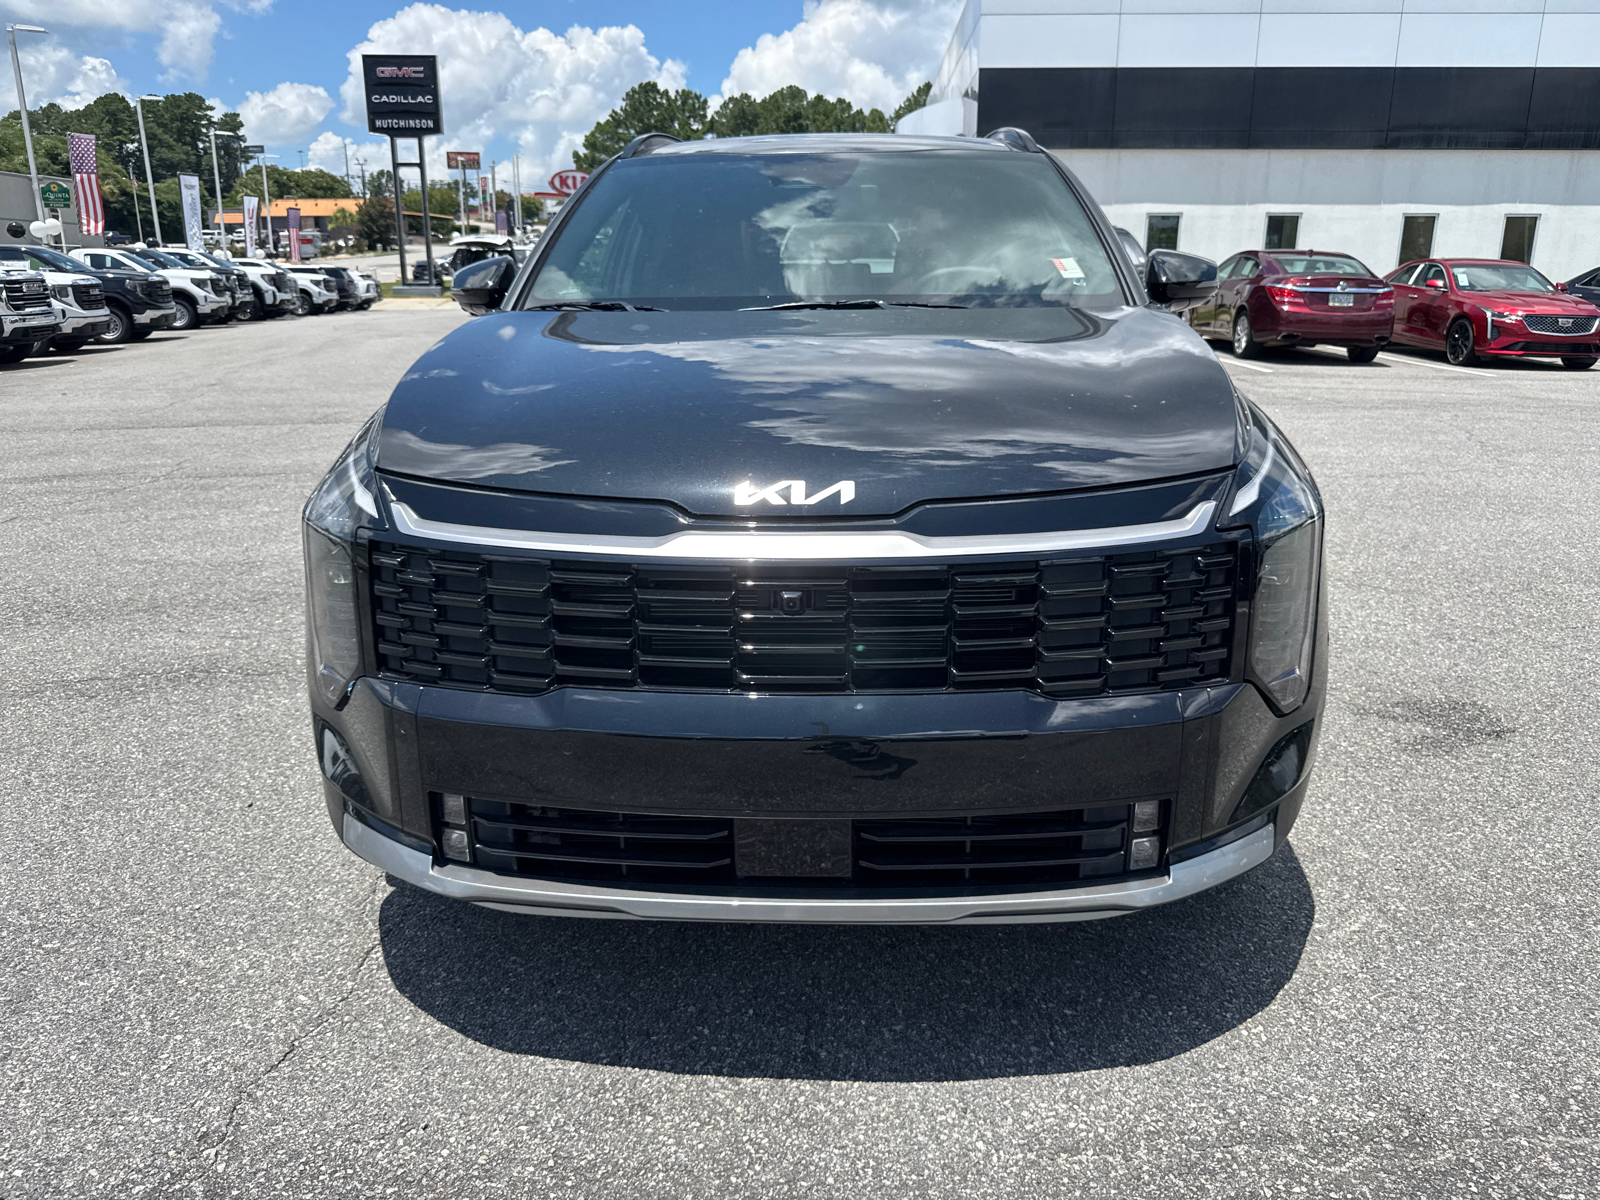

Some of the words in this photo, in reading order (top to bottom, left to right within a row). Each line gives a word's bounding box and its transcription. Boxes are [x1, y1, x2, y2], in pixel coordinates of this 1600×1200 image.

[376, 67, 424, 77] GMC
[371, 95, 433, 103] CADILLAC
[375, 119, 434, 129] HUTCHINSON
[734, 480, 856, 505] KIA
